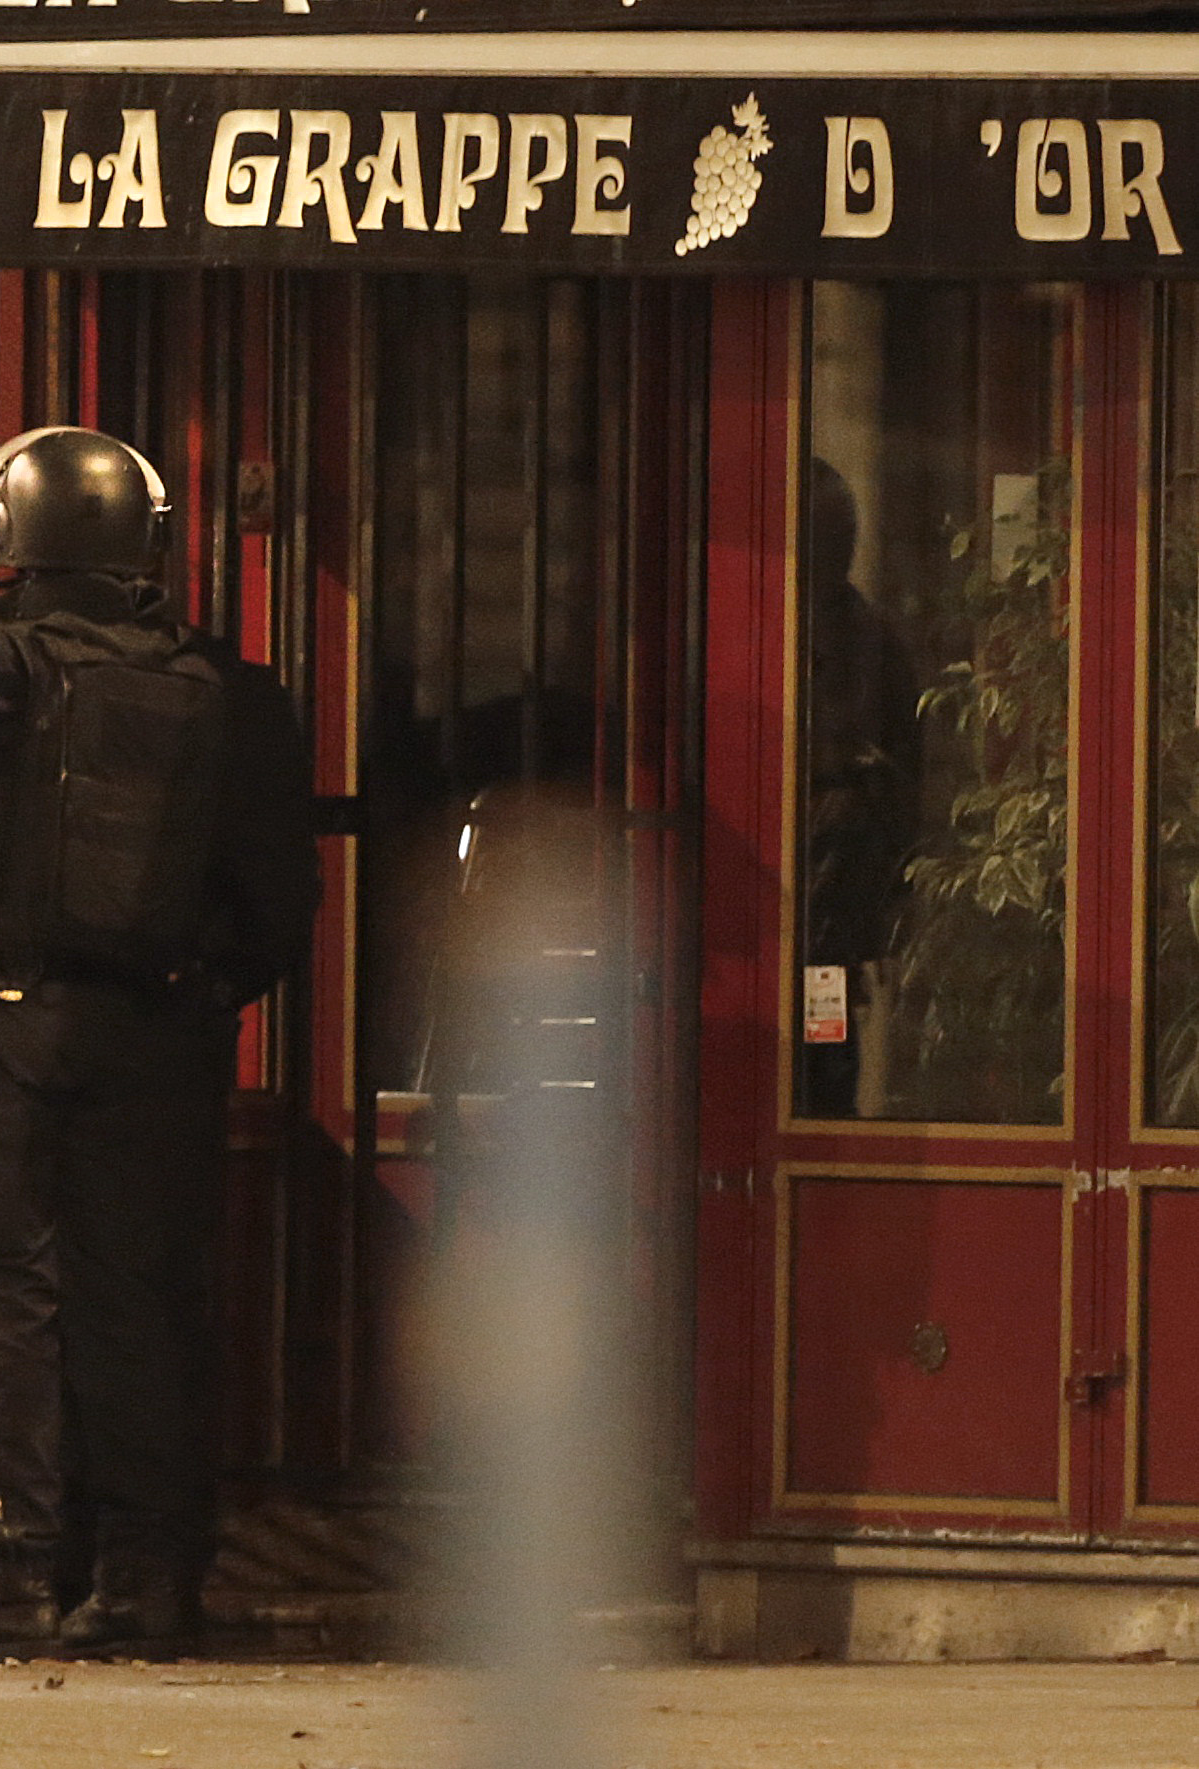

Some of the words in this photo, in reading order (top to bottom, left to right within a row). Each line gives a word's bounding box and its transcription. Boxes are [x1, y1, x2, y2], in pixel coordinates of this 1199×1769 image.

[33, 109, 167, 229] LA
[204, 109, 633, 244] GRAPPE
[821, 116, 894, 239] D
[980, 119, 1183, 256] 'OR
